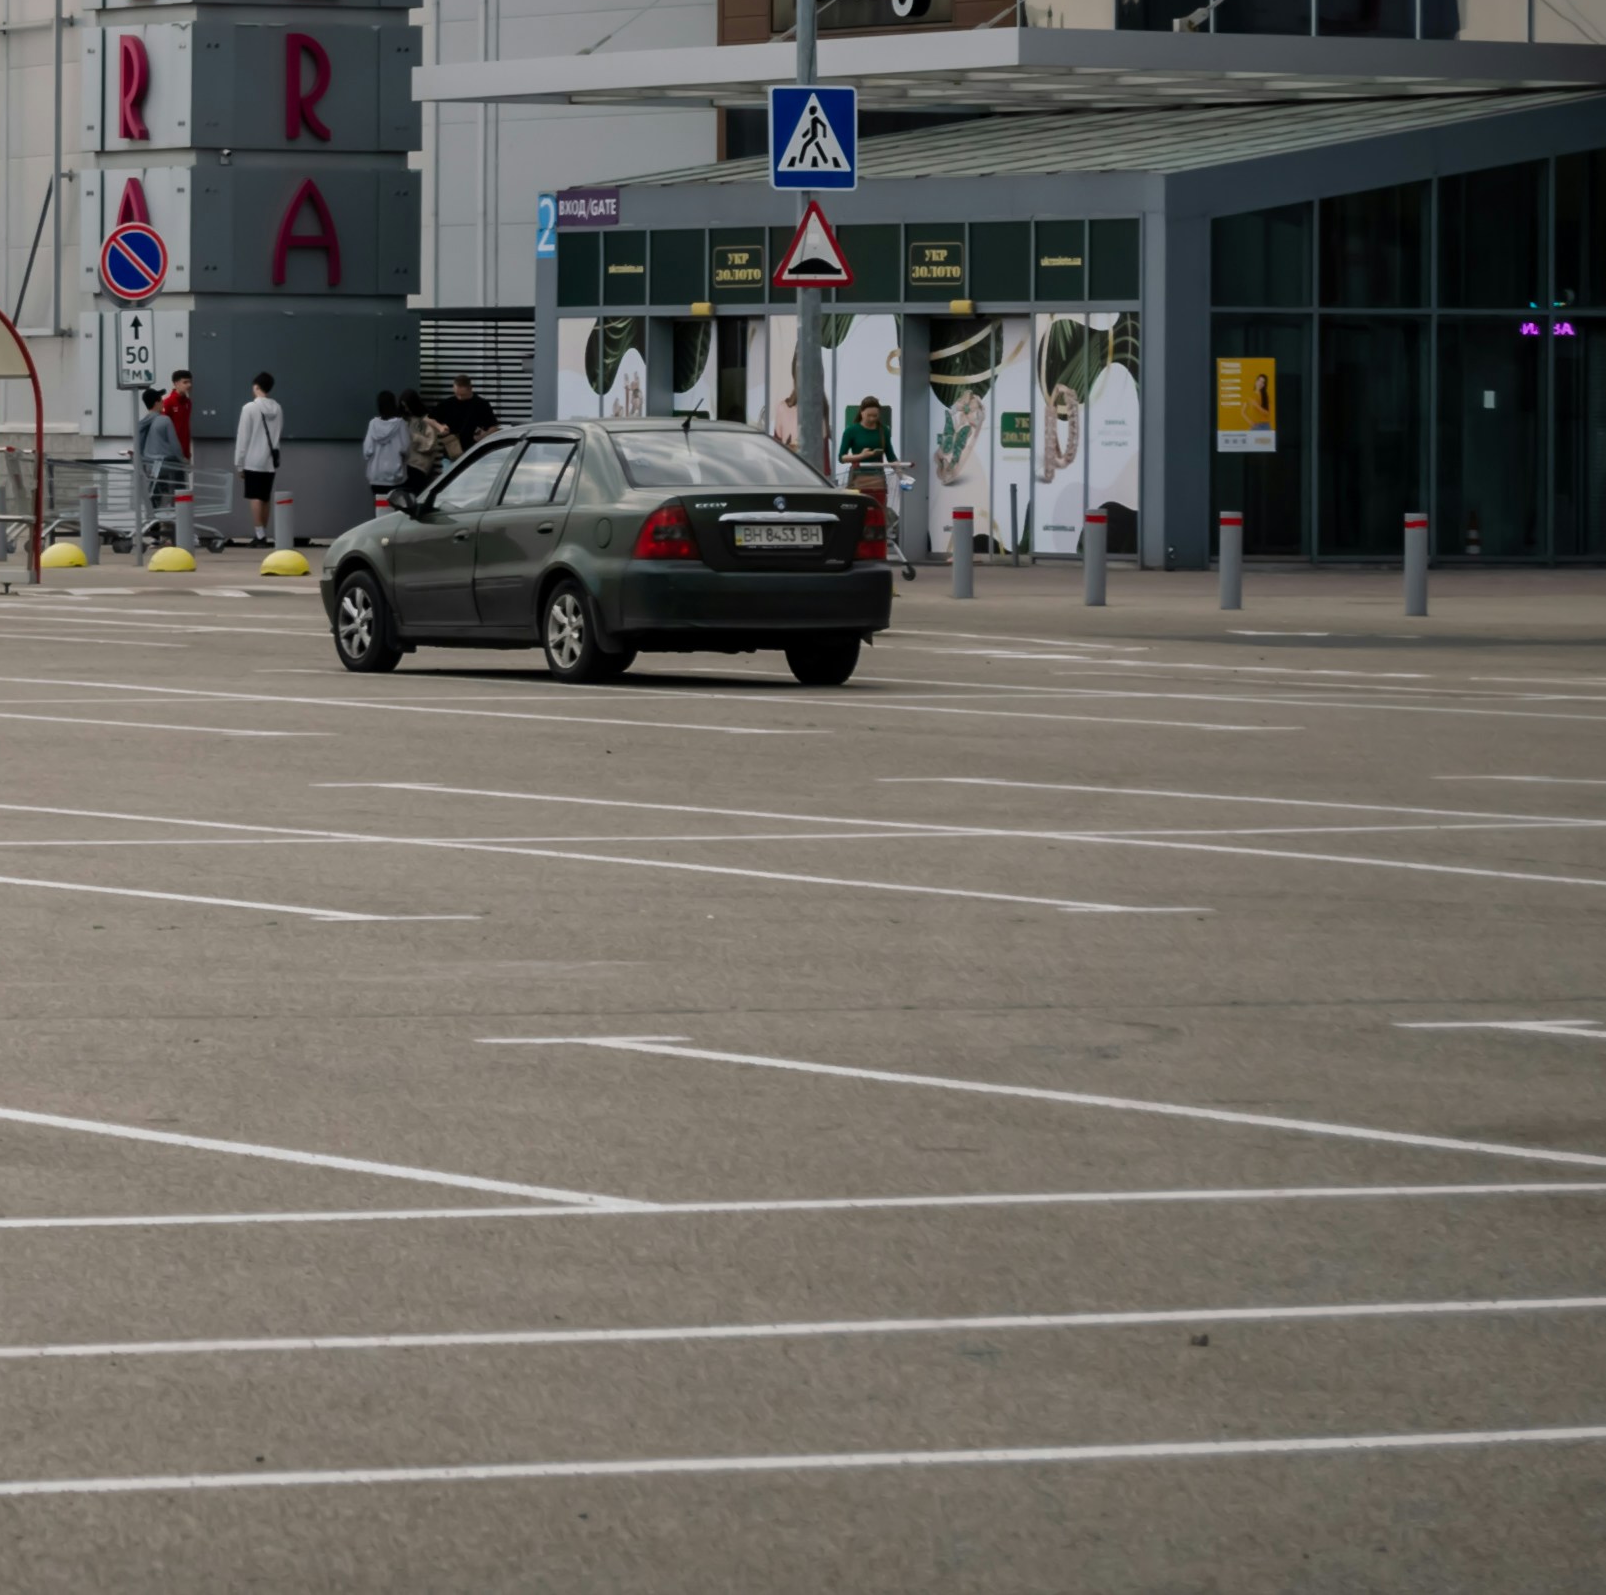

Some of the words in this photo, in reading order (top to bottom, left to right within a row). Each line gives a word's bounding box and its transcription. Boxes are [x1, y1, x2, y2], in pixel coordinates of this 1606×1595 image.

[538, 198, 555, 251] 2
[727, 253, 749, 265] УКР
[925, 249, 948, 262] УКР
[716, 268, 761, 281] ЗОЛОТО
[912, 266, 961, 278] ЗОЛОТО
[126, 346, 149, 364] 50
[744, 527, 763, 542] BH
[766, 527, 797, 542] 8453
[801, 527, 820, 542] BH
